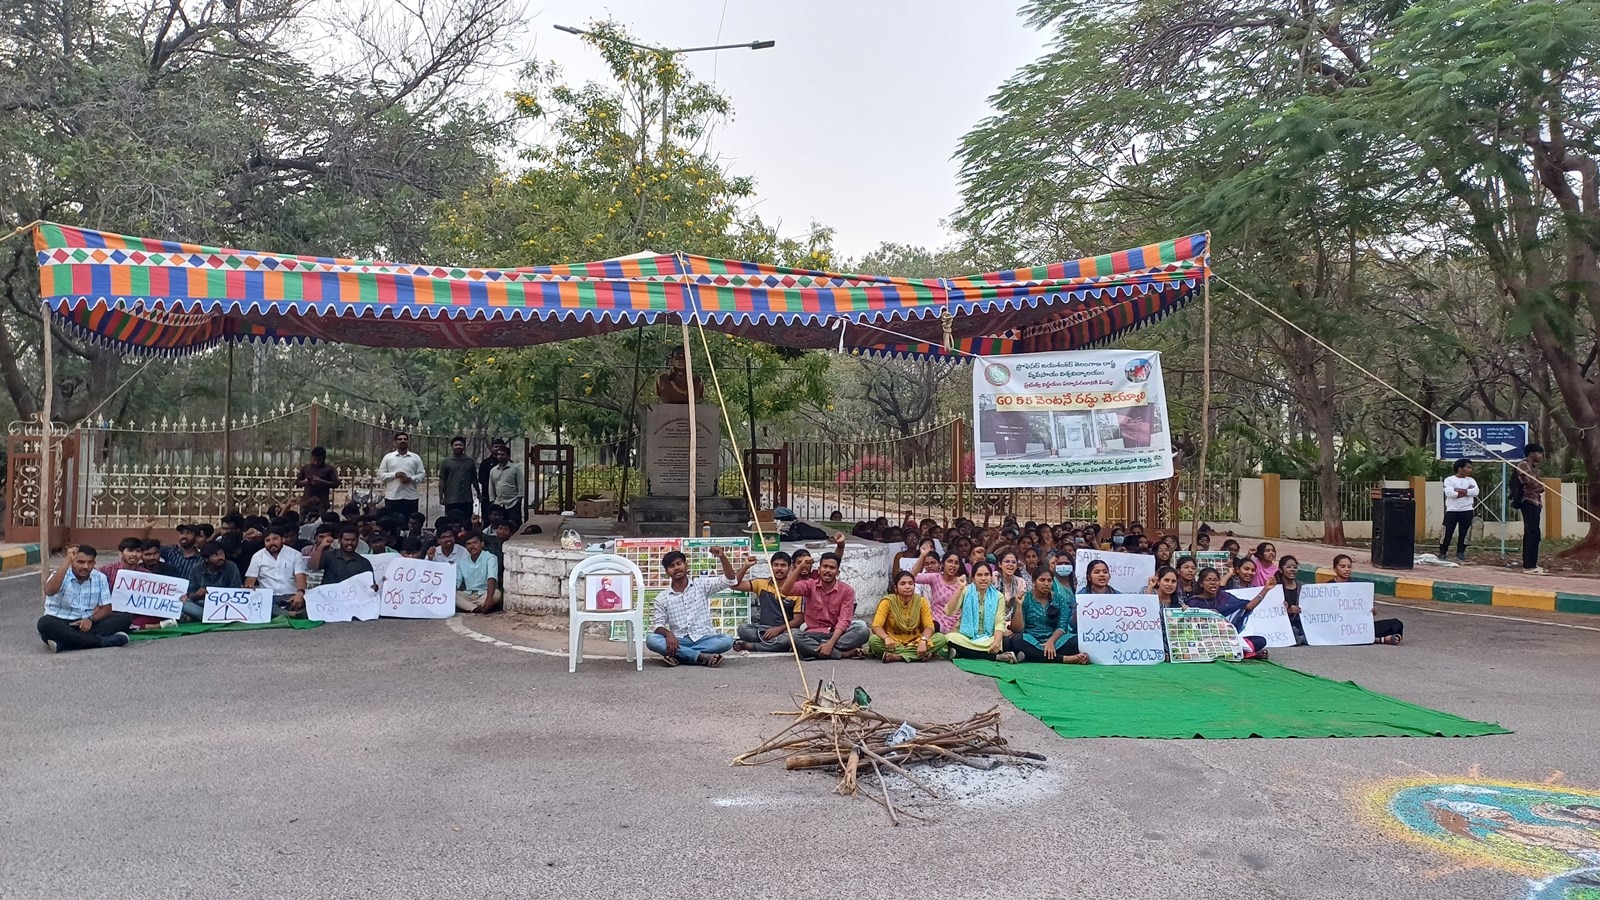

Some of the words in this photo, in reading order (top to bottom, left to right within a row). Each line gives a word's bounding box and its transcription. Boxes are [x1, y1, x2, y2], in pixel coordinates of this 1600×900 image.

[997, 396, 1012, 405] GO
[1036, 393, 1072, 406] వెంటనే
[1076, 393, 1098, 408] రద్దు
[1459, 428, 1482, 439] SBI
[1109, 565, 1136, 576] ARSITY
[116, 576, 178, 596] NURTURE
[1301, 586, 1340, 598] STUDENTS
[126, 594, 182, 614] NATURE
[1338, 599, 1364, 611] POWER
[1341, 623, 1368, 636] POWER
